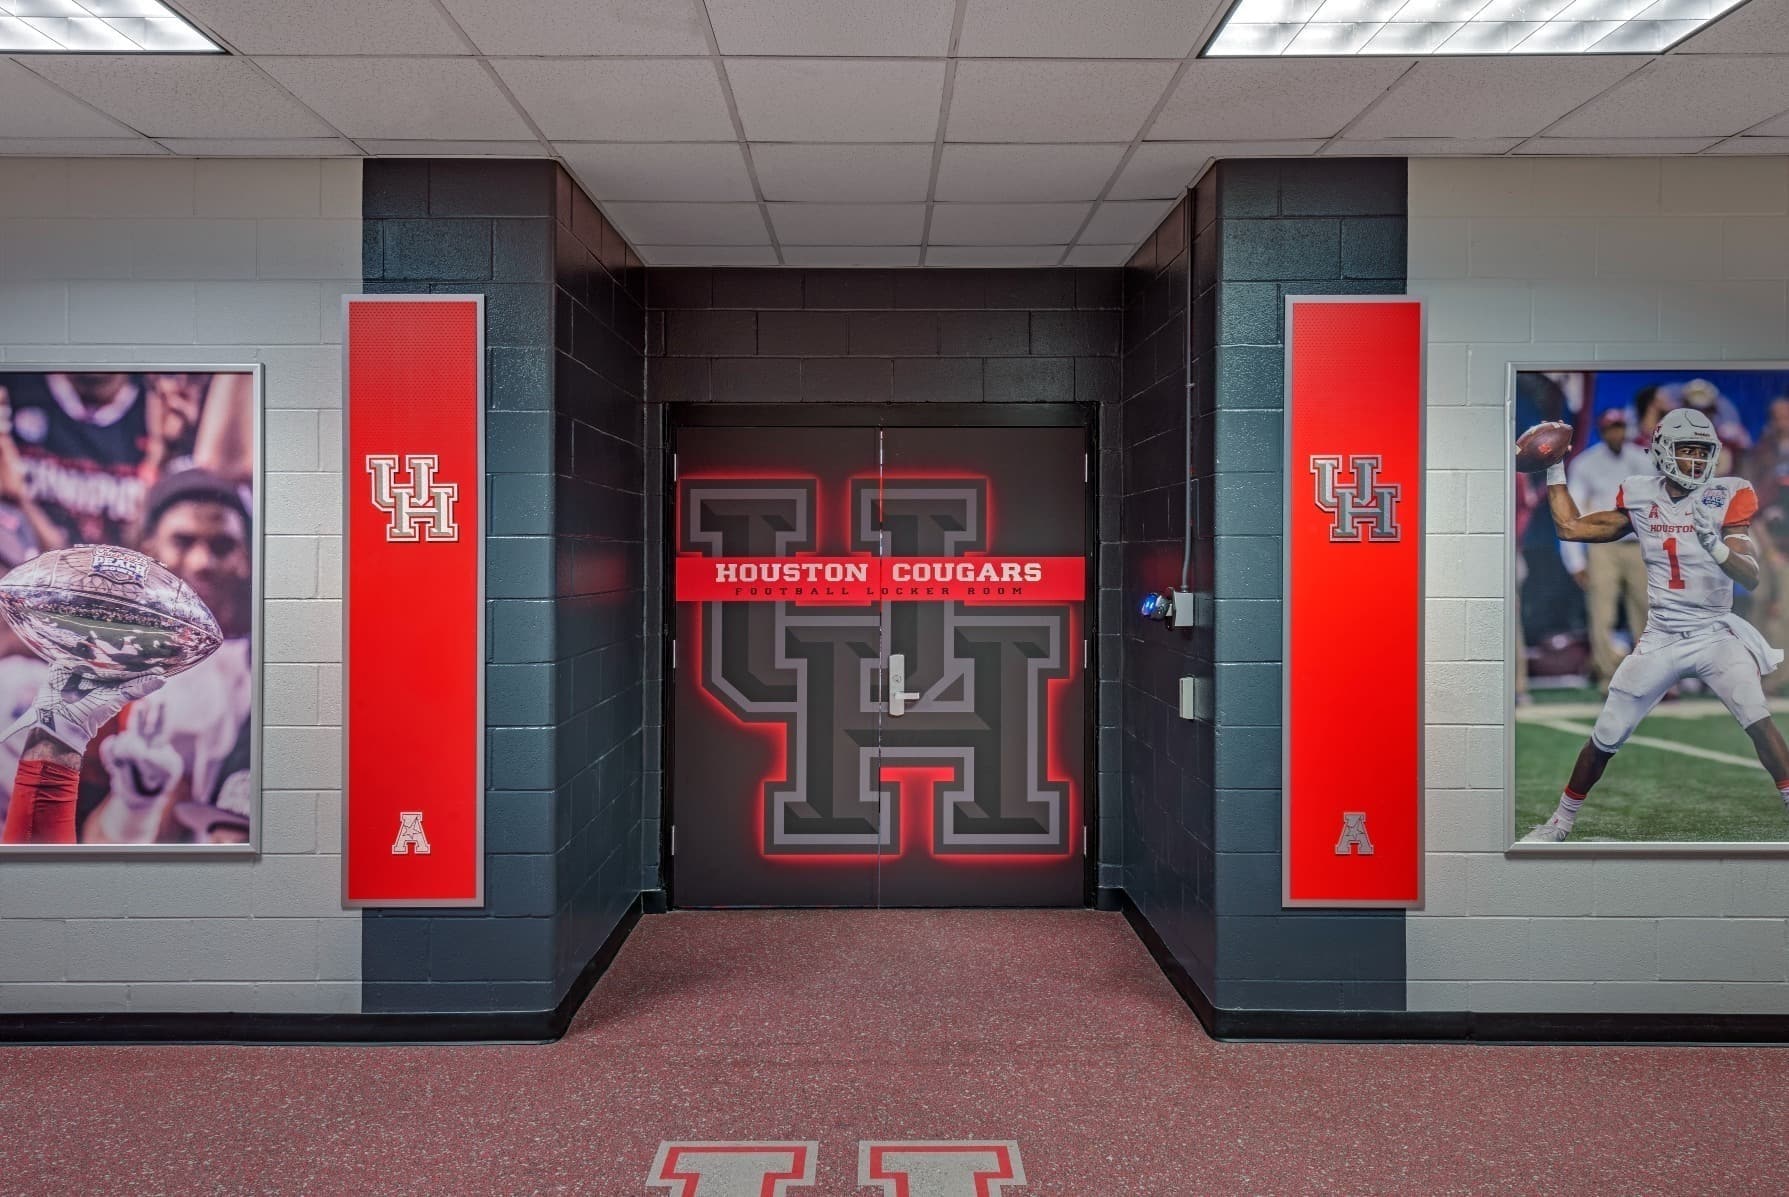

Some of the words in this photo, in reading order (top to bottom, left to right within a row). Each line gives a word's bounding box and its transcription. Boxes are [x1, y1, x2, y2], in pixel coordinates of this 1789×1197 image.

[1650, 524, 1696, 533] HOUSTON
[1662, 537, 1686, 590] 1
[715, 563, 869, 583] HOUSTON
[892, 562, 1042, 582] COUGARS
[735, 587, 849, 596] FOOTBALL
[866, 587, 950, 595] LOCKER
[968, 587, 1023, 595] ROOM
